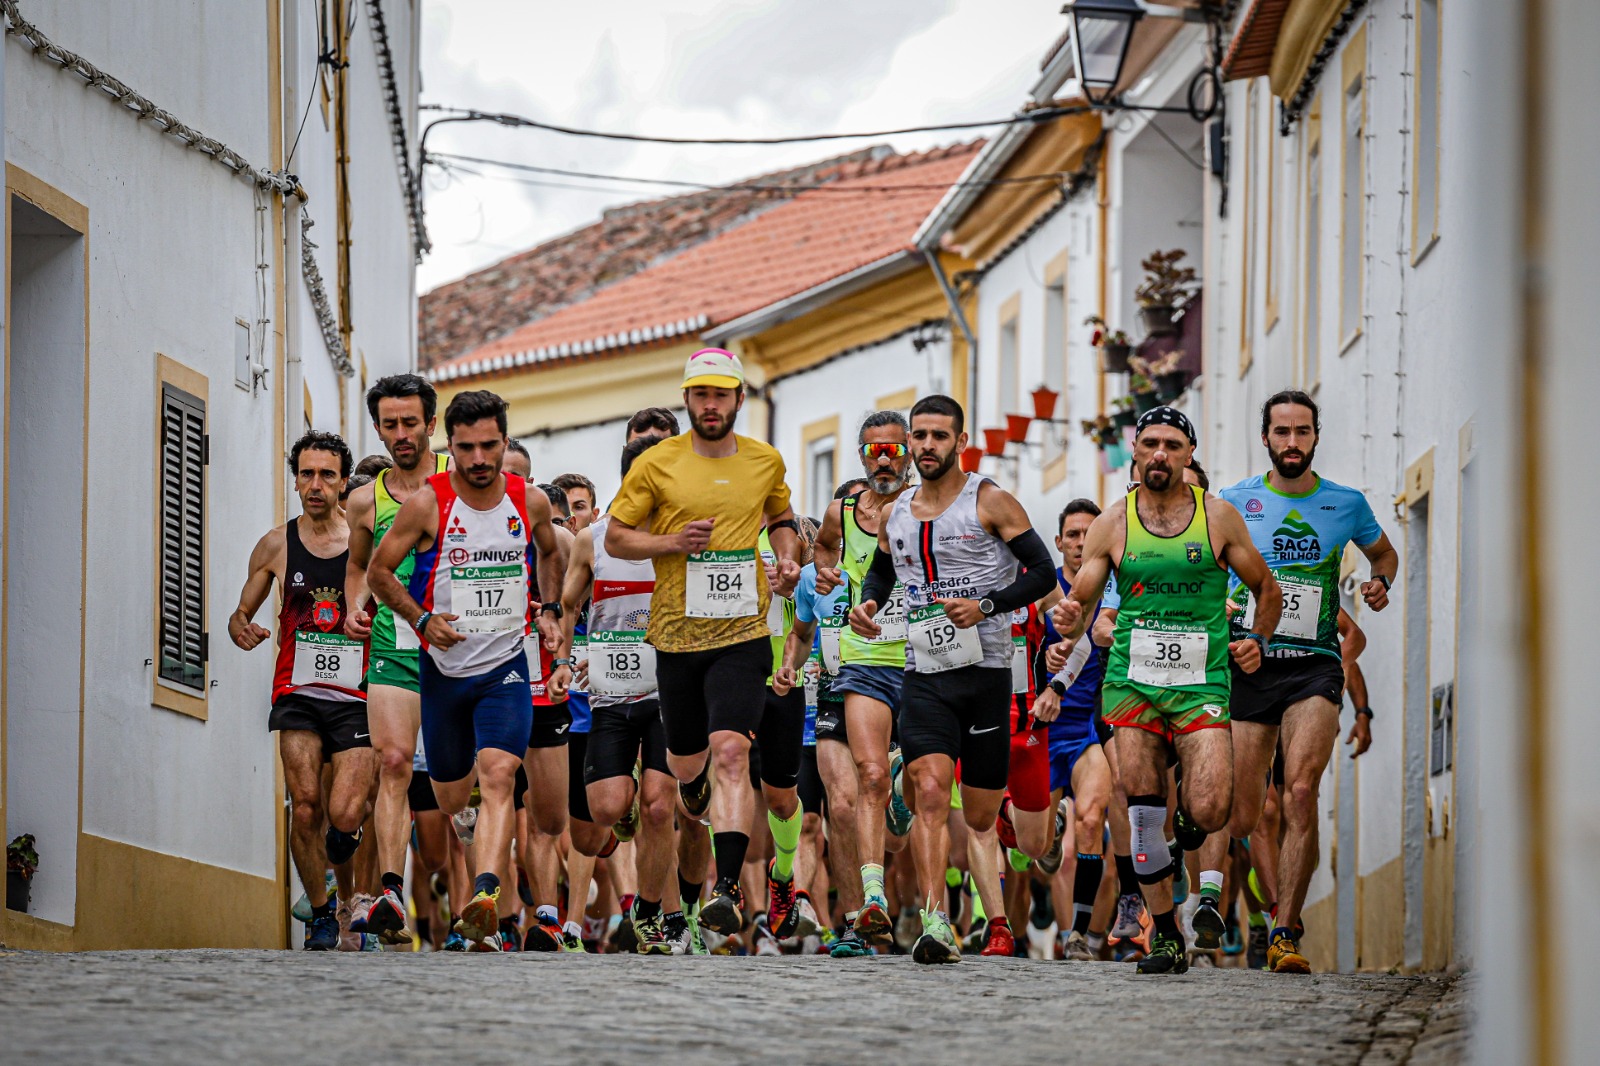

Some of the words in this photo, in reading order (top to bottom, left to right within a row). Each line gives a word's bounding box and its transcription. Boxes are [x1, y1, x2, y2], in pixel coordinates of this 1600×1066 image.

[1272, 538, 1321, 552] SACA
[473, 550, 523, 562] UNIVEX
[702, 551, 717, 561] CA
[1272, 551, 1320, 561] TRILHOS
[465, 568, 480, 578] CA
[481, 570, 502, 578] Crédito
[707, 573, 743, 592] 184
[1280, 574, 1300, 582] Crédito
[1300, 576, 1321, 586] Agrícola
[475, 589, 504, 608] 117
[707, 592, 741, 600] PEREIRA
[926, 592, 935, 603] &
[465, 607, 512, 617] FIGUEIREDO
[917, 609, 929, 619] CA
[1281, 611, 1301, 621] EIRA
[874, 616, 905, 625] FIGUEIR
[1146, 619, 1160, 629] CA
[1161, 623, 1183, 631] Crédito
[1183, 624, 1206, 632] Agrícola
[307, 632, 321, 643] CA
[601, 631, 615, 641] CA
[615, 634, 635, 642] Crédito
[925, 624, 956, 648] 159
[927, 642, 962, 656] FERREIRA
[1154, 642, 1182, 661] 38
[314, 654, 341, 672] 88
[606, 653, 641, 671] 183
[1144, 660, 1190, 670] CARVALHO
[314, 671, 338, 679] BESSA
[605, 671, 642, 680] FONSECA
